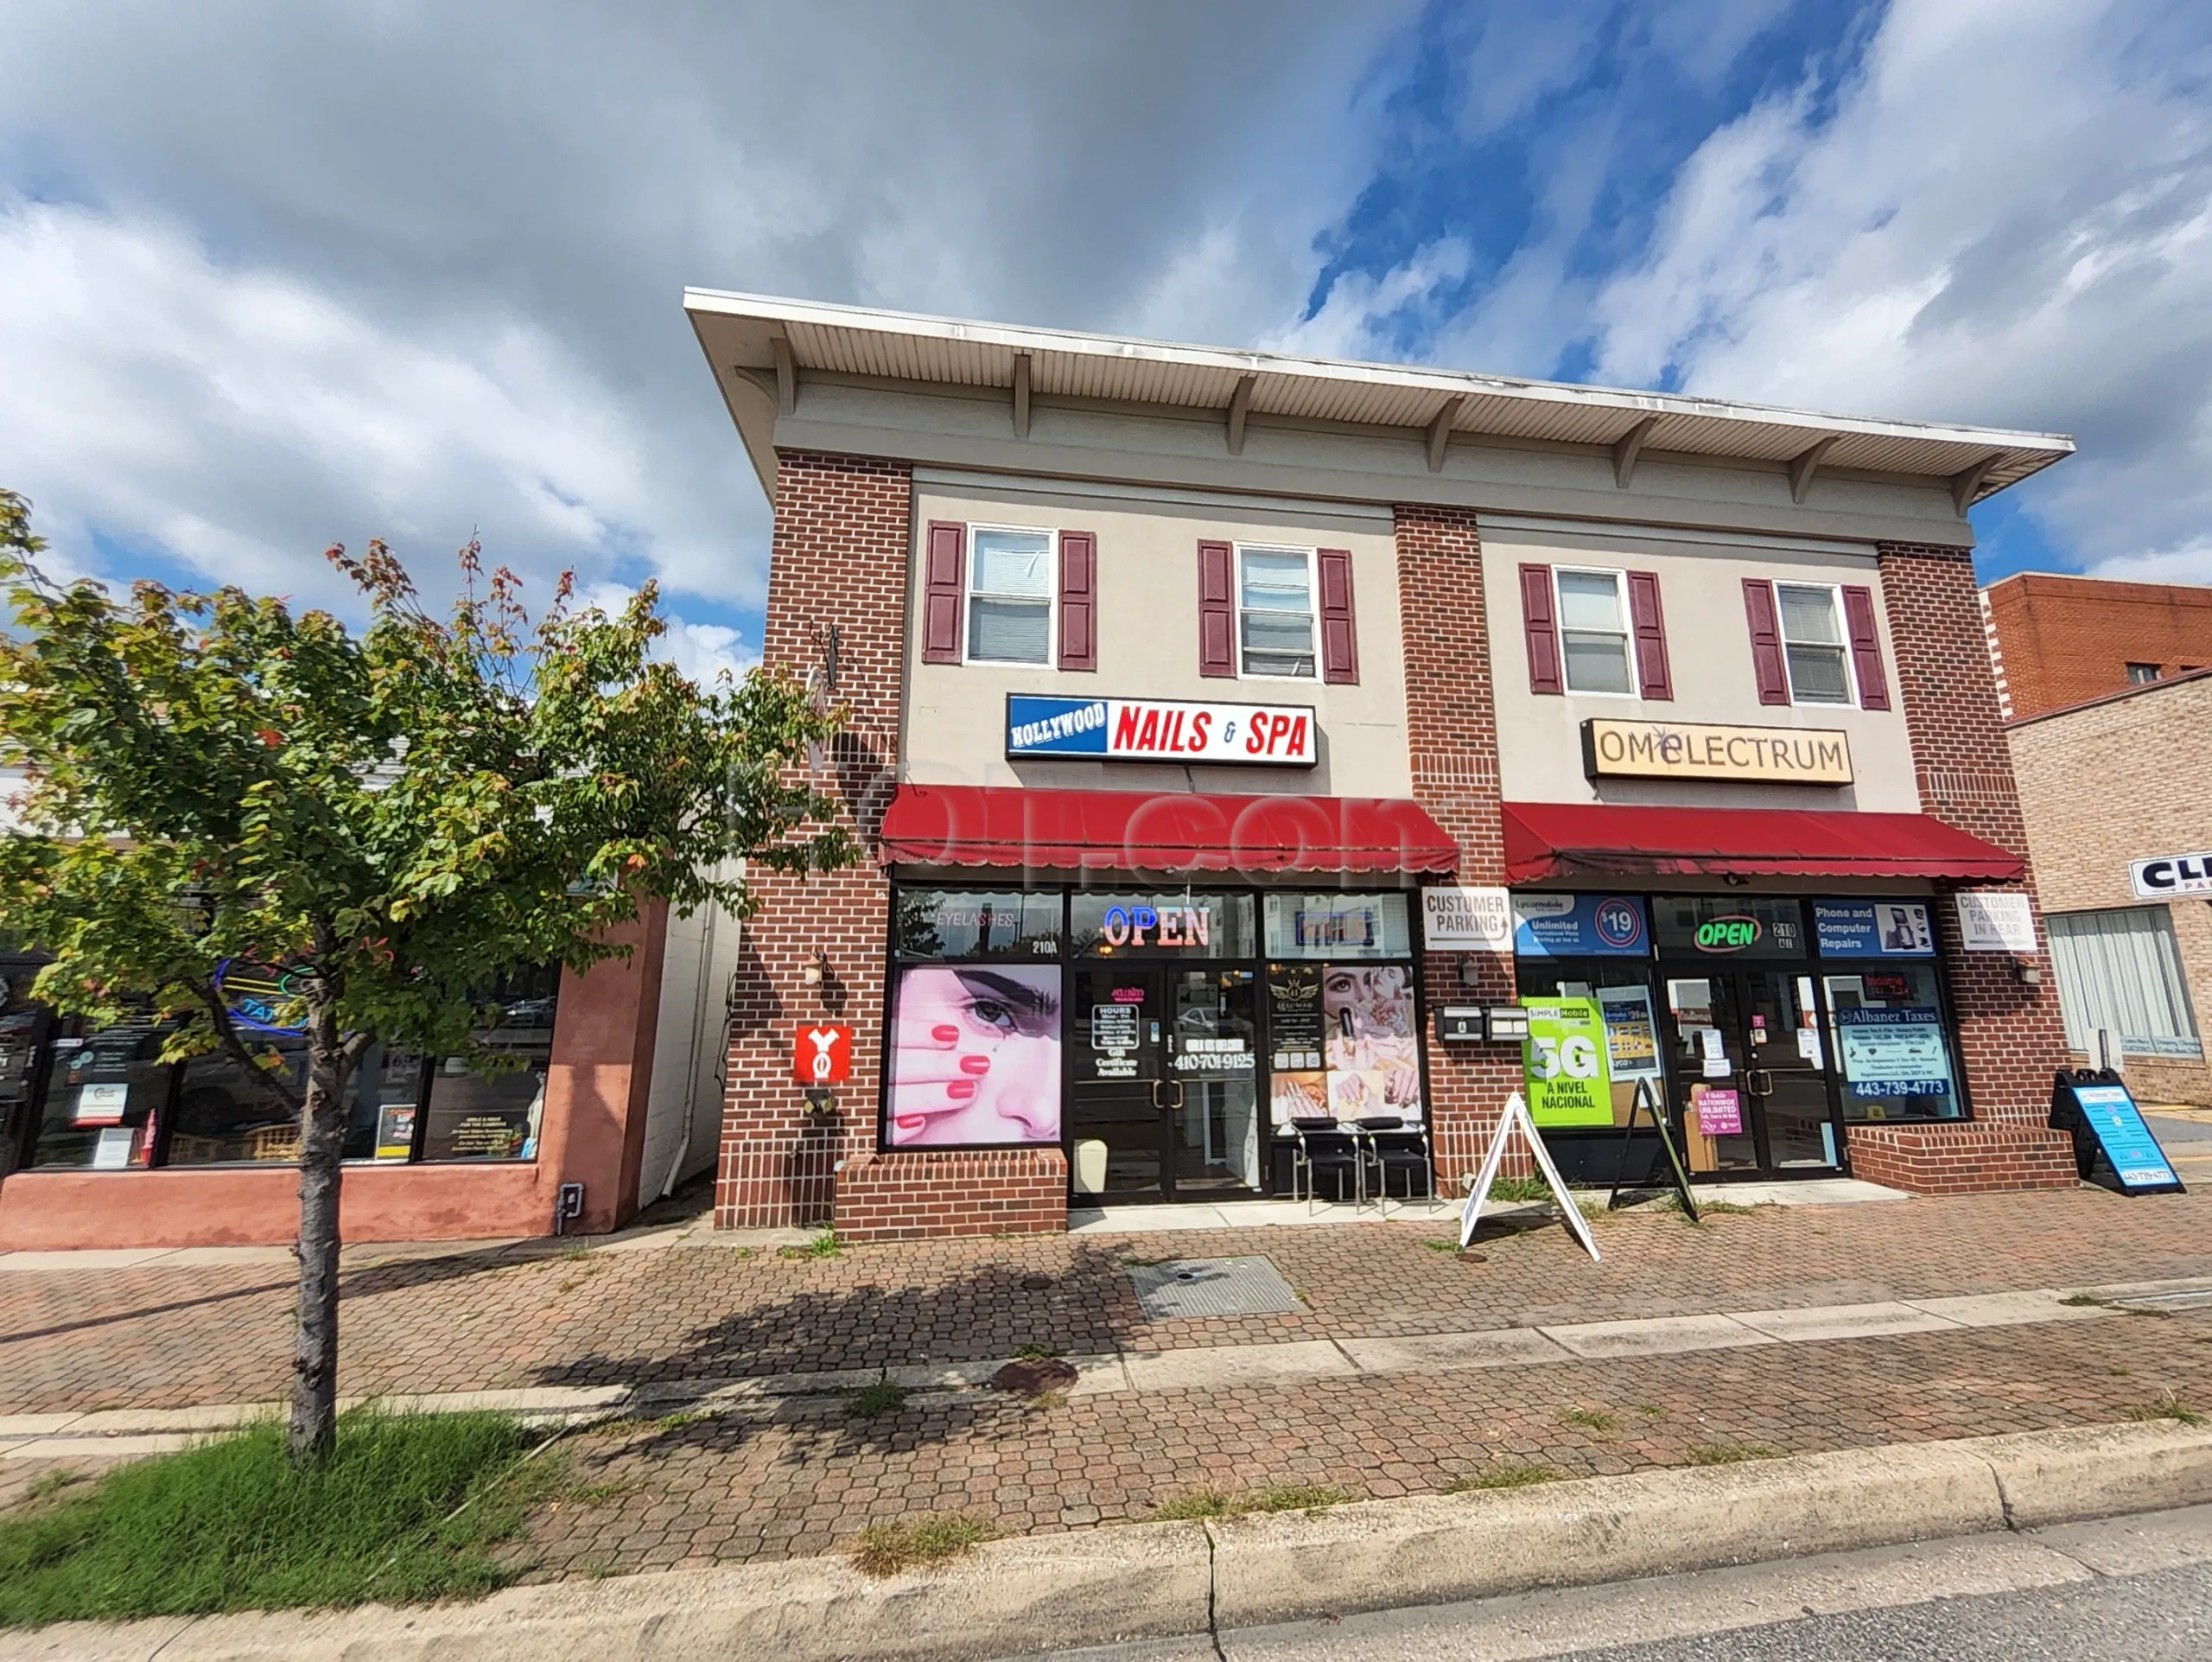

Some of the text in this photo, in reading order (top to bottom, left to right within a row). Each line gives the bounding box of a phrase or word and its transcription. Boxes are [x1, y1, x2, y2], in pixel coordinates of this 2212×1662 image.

[1011, 702, 1307, 756] HOLLYWOOD NAILS & SPA
[2184, 881, 2212, 889] PA
[1427, 895, 1504, 913] CUSTOMER
[1961, 895, 2025, 908] CUSTOMER
[936, 912, 1014, 927] EYELASHES
[1815, 907, 1872, 919] Phone and
[1968, 910, 2021, 922] PARKING
[1104, 906, 1210, 946] OPEN
[1437, 914, 1498, 932] PARKING
[1532, 920, 1579, 930] Unlimited
[1602, 911, 1632, 931] $19
[1818, 921, 1872, 934] Computer
[1698, 922, 1755, 946] OPEN
[1773, 923, 1796, 937] 210
[1974, 923, 2021, 935] IN REAR
[1033, 940, 1058, 954] 210A
[1821, 938, 1862, 950] Repairs
[1853, 1009, 1936, 1022] Albanez Taxes
[1174, 1053, 1255, 1070] 410-701-9125
[1530, 1035, 1599, 1079] 5G
[1547, 1080, 1587, 1094] A NIVEL
[1856, 1080, 1944, 1096] 443-739-4773
[1541, 1095, 1596, 1110] NACIONAL
